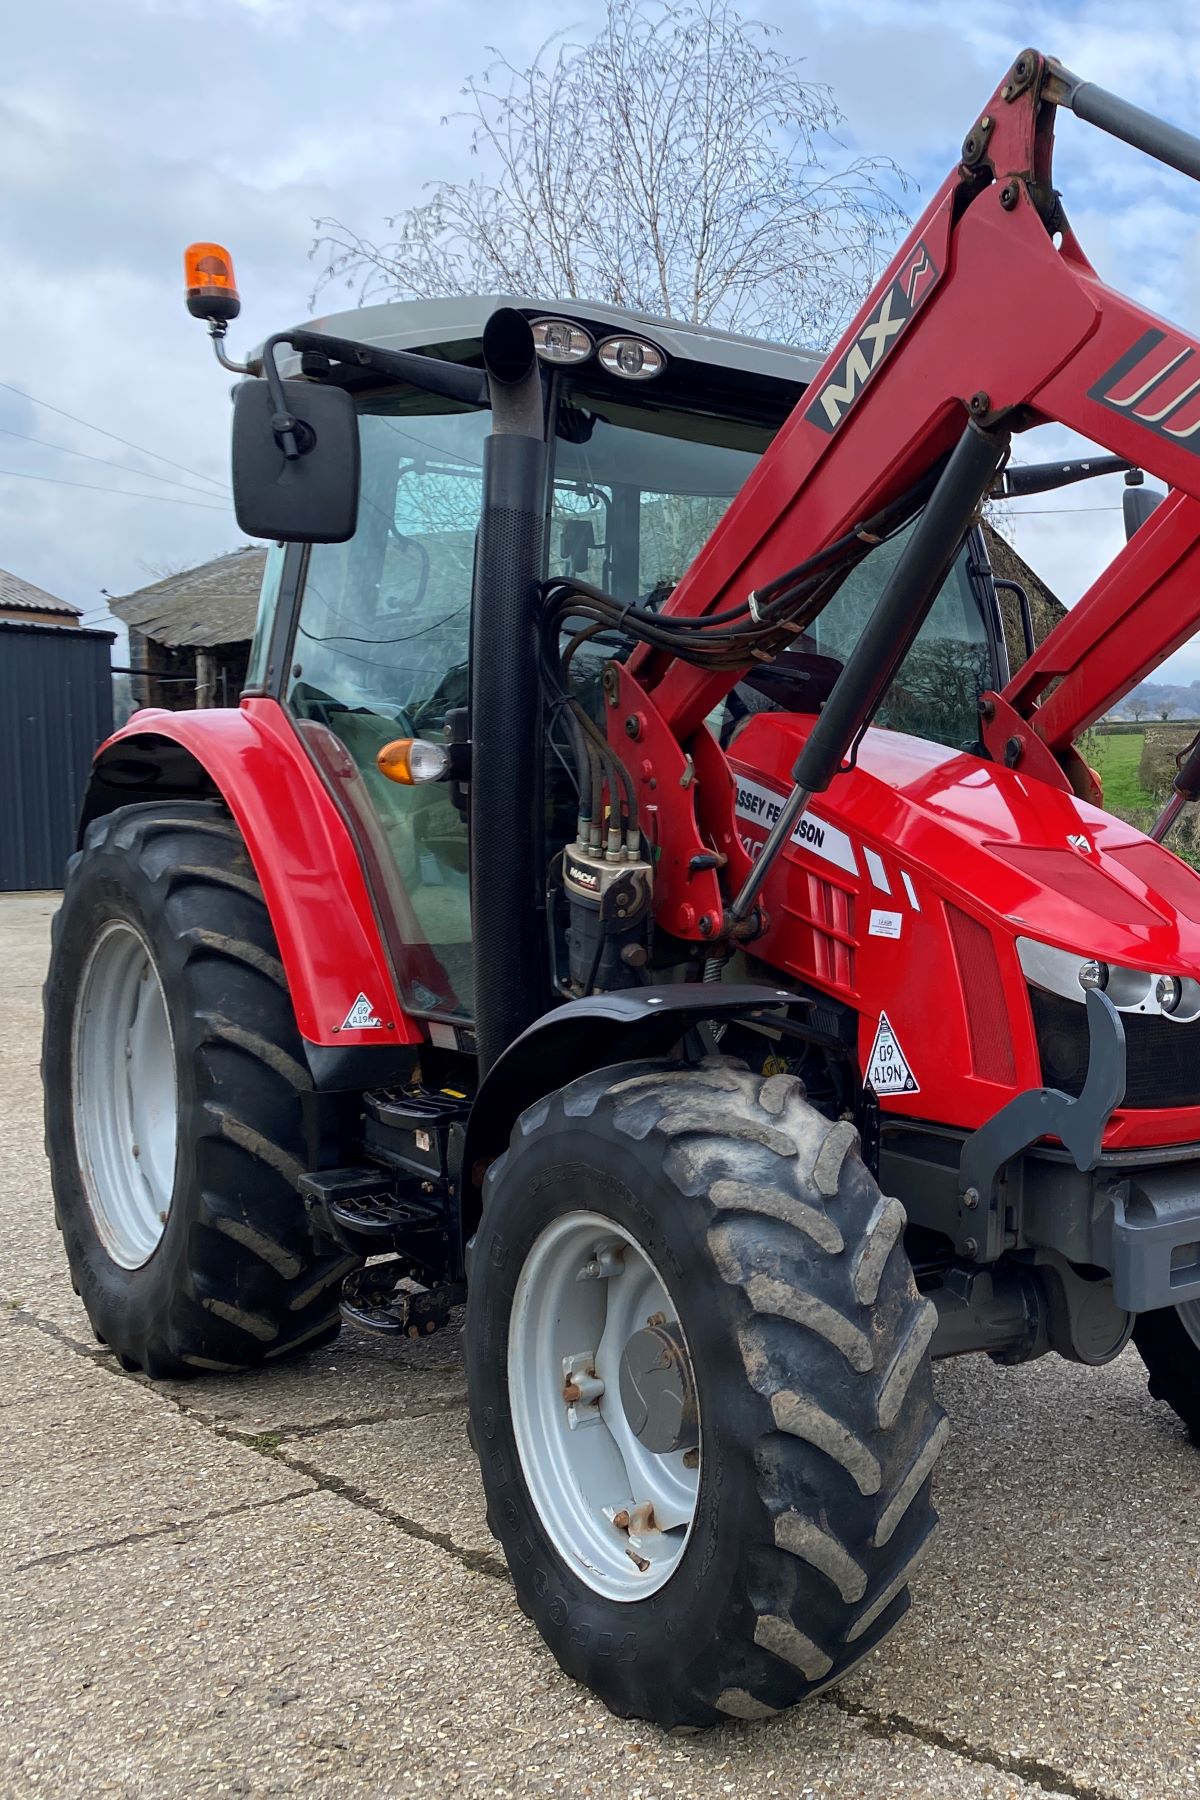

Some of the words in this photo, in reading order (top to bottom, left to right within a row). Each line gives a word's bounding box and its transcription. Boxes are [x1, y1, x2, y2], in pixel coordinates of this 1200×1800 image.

[820, 288, 906, 427] MX
[735, 787, 766, 816] ASSEY
[766, 802, 825, 848] FESON
[569, 867, 597, 884] MACH
